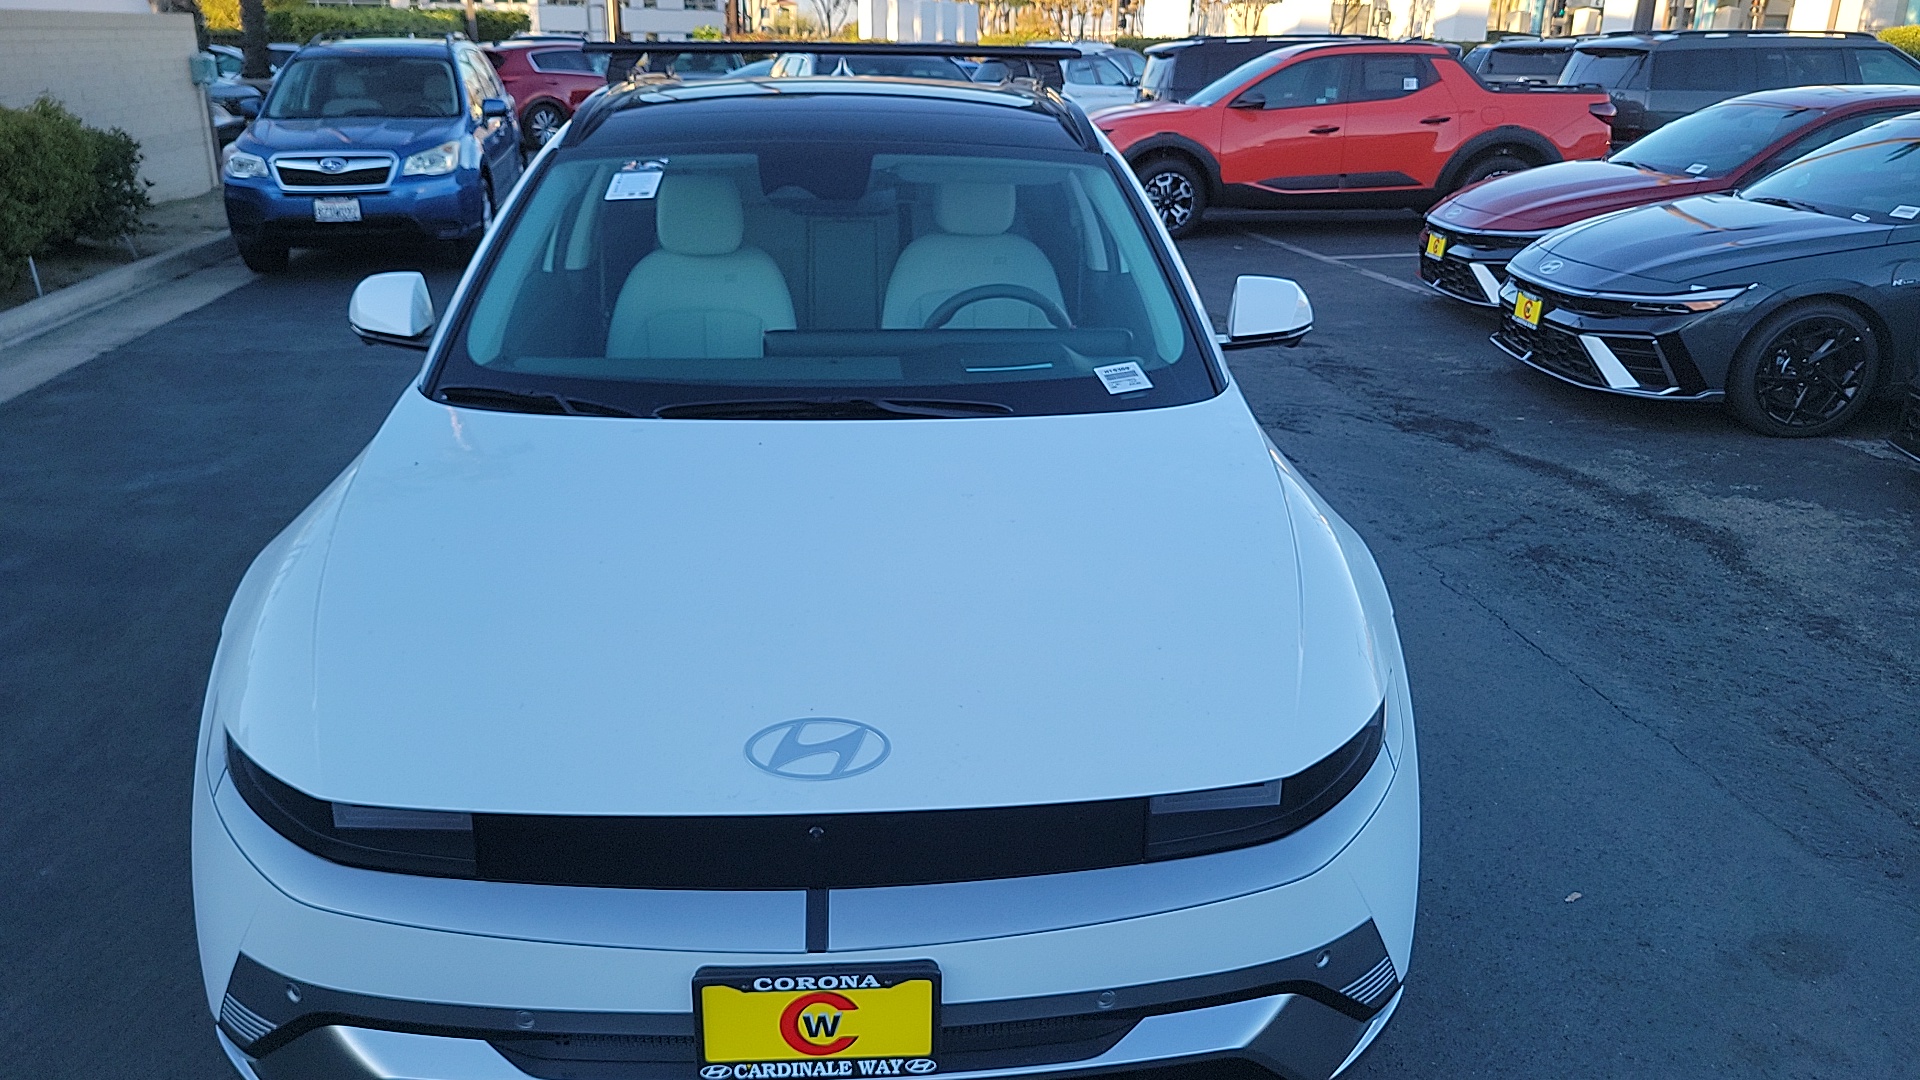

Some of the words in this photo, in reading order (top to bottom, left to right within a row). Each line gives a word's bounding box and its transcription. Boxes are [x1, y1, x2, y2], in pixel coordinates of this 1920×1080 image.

[753, 974, 881, 991] CORONA
[734, 1060, 853, 1079] CARDINALE
[857, 1058, 907, 1075] WAY
